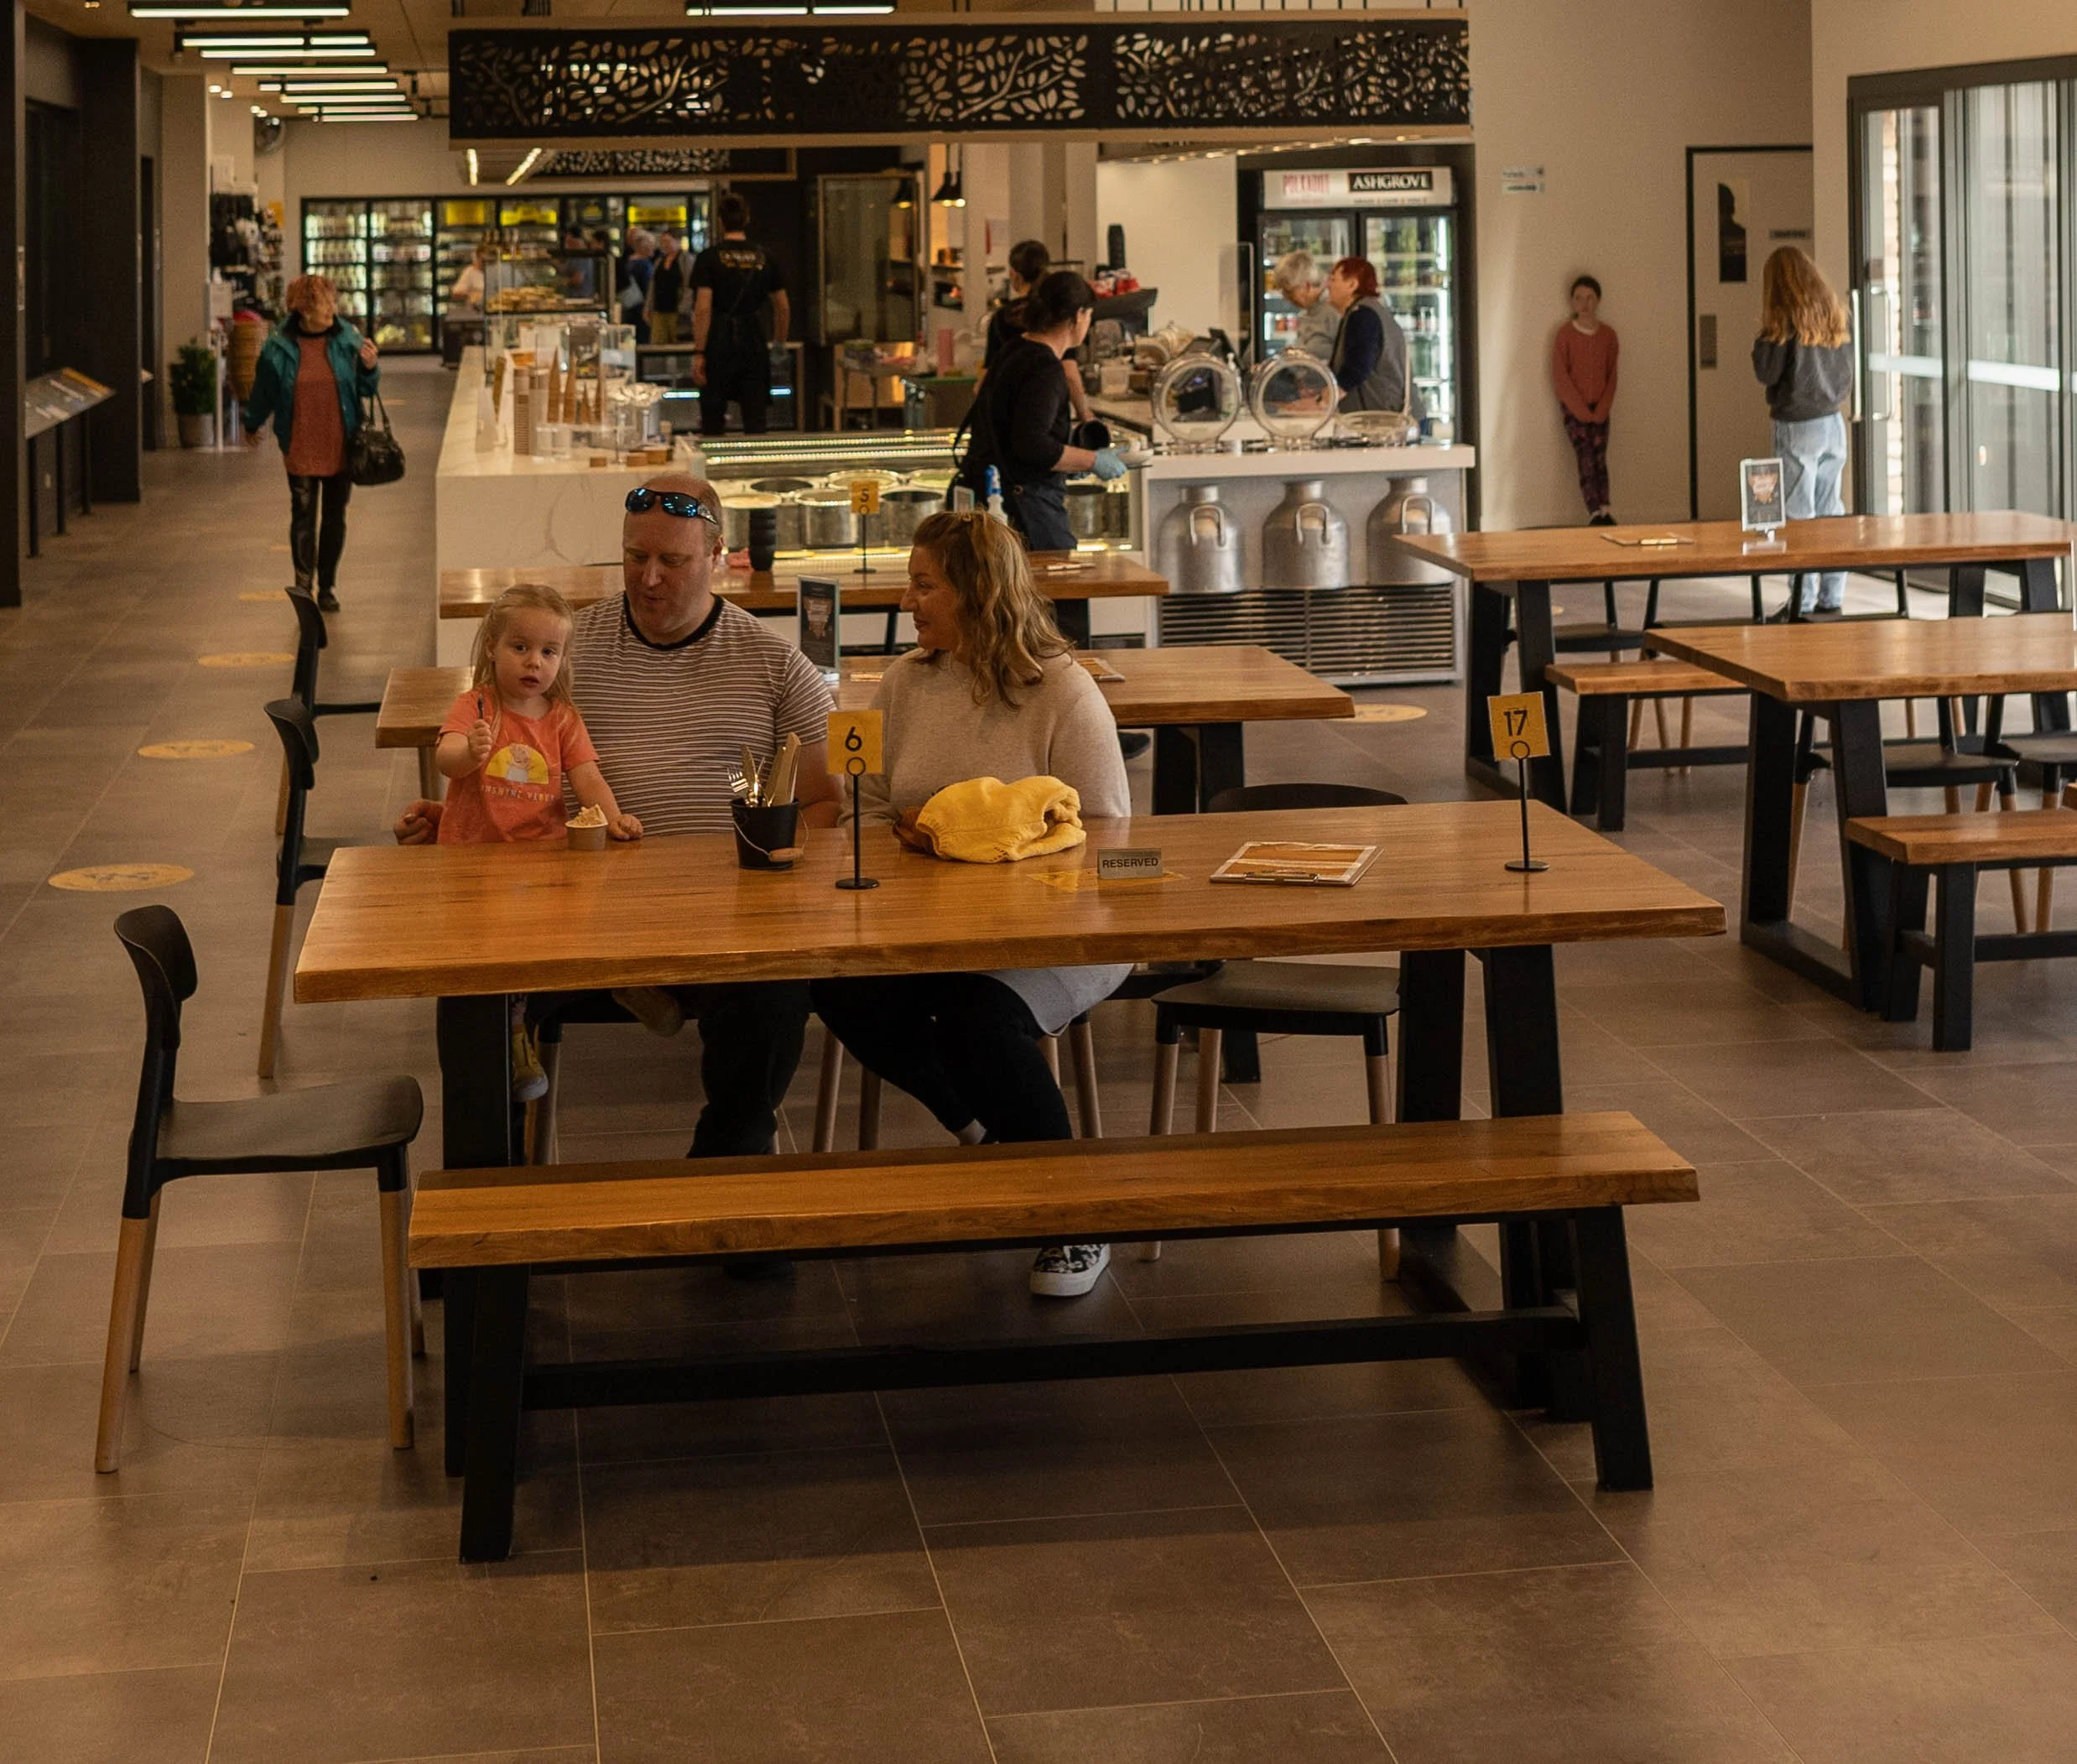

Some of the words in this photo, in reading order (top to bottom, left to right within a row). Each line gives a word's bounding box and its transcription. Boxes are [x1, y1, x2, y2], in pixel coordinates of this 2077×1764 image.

[1352, 174, 1430, 190] ASHGROVE
[860, 487, 870, 503] 5
[1503, 709, 1528, 737] 17
[845, 726, 863, 752] 6
[1101, 857, 1159, 868] RESERVED
